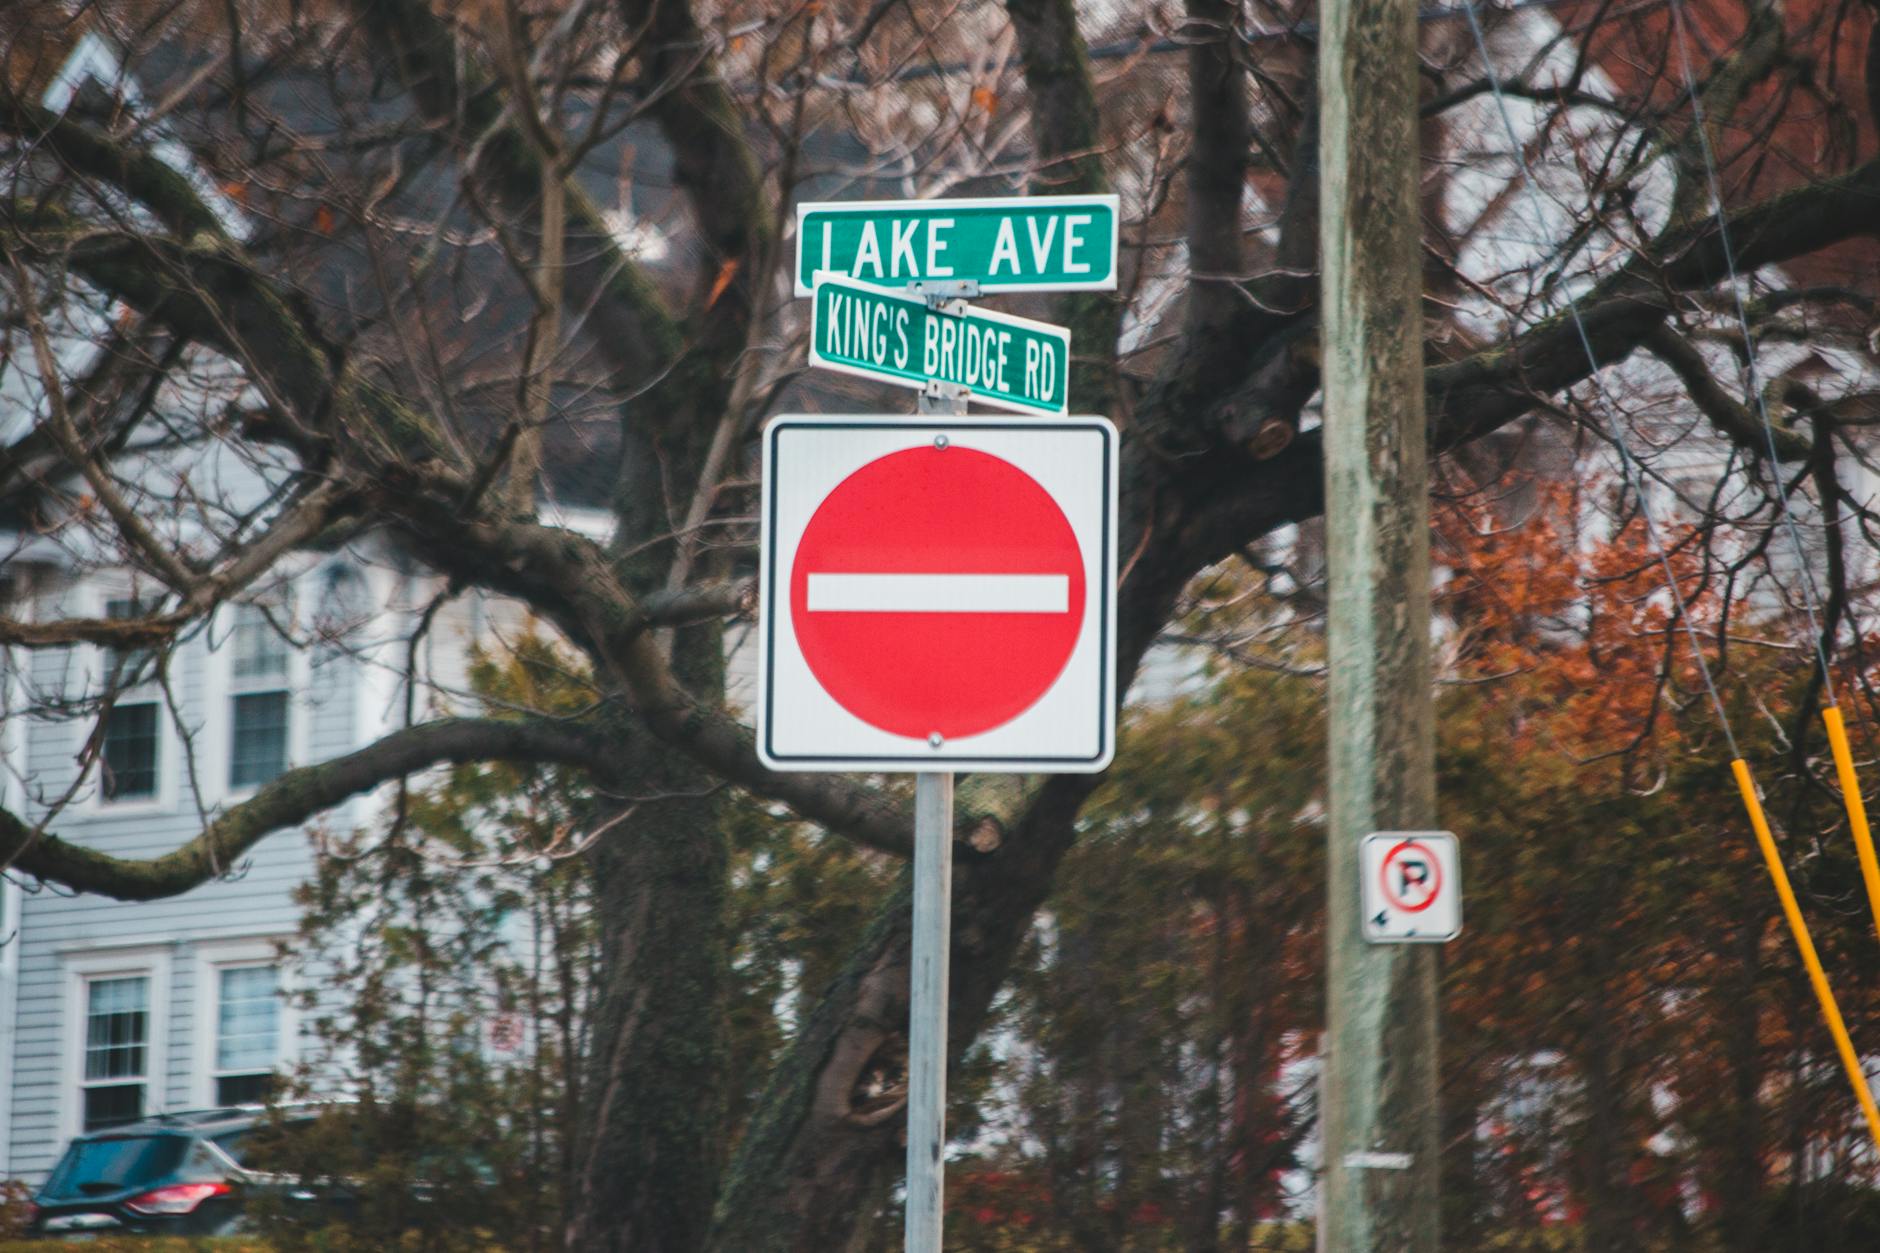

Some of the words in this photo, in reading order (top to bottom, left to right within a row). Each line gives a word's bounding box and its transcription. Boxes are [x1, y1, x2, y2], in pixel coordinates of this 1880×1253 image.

[822, 218, 955, 278] LAKE
[988, 214, 1092, 276] AVE
[826, 291, 910, 370] KING'S
[923, 316, 1011, 393] BRIDGE
[1024, 338, 1056, 403] RD
